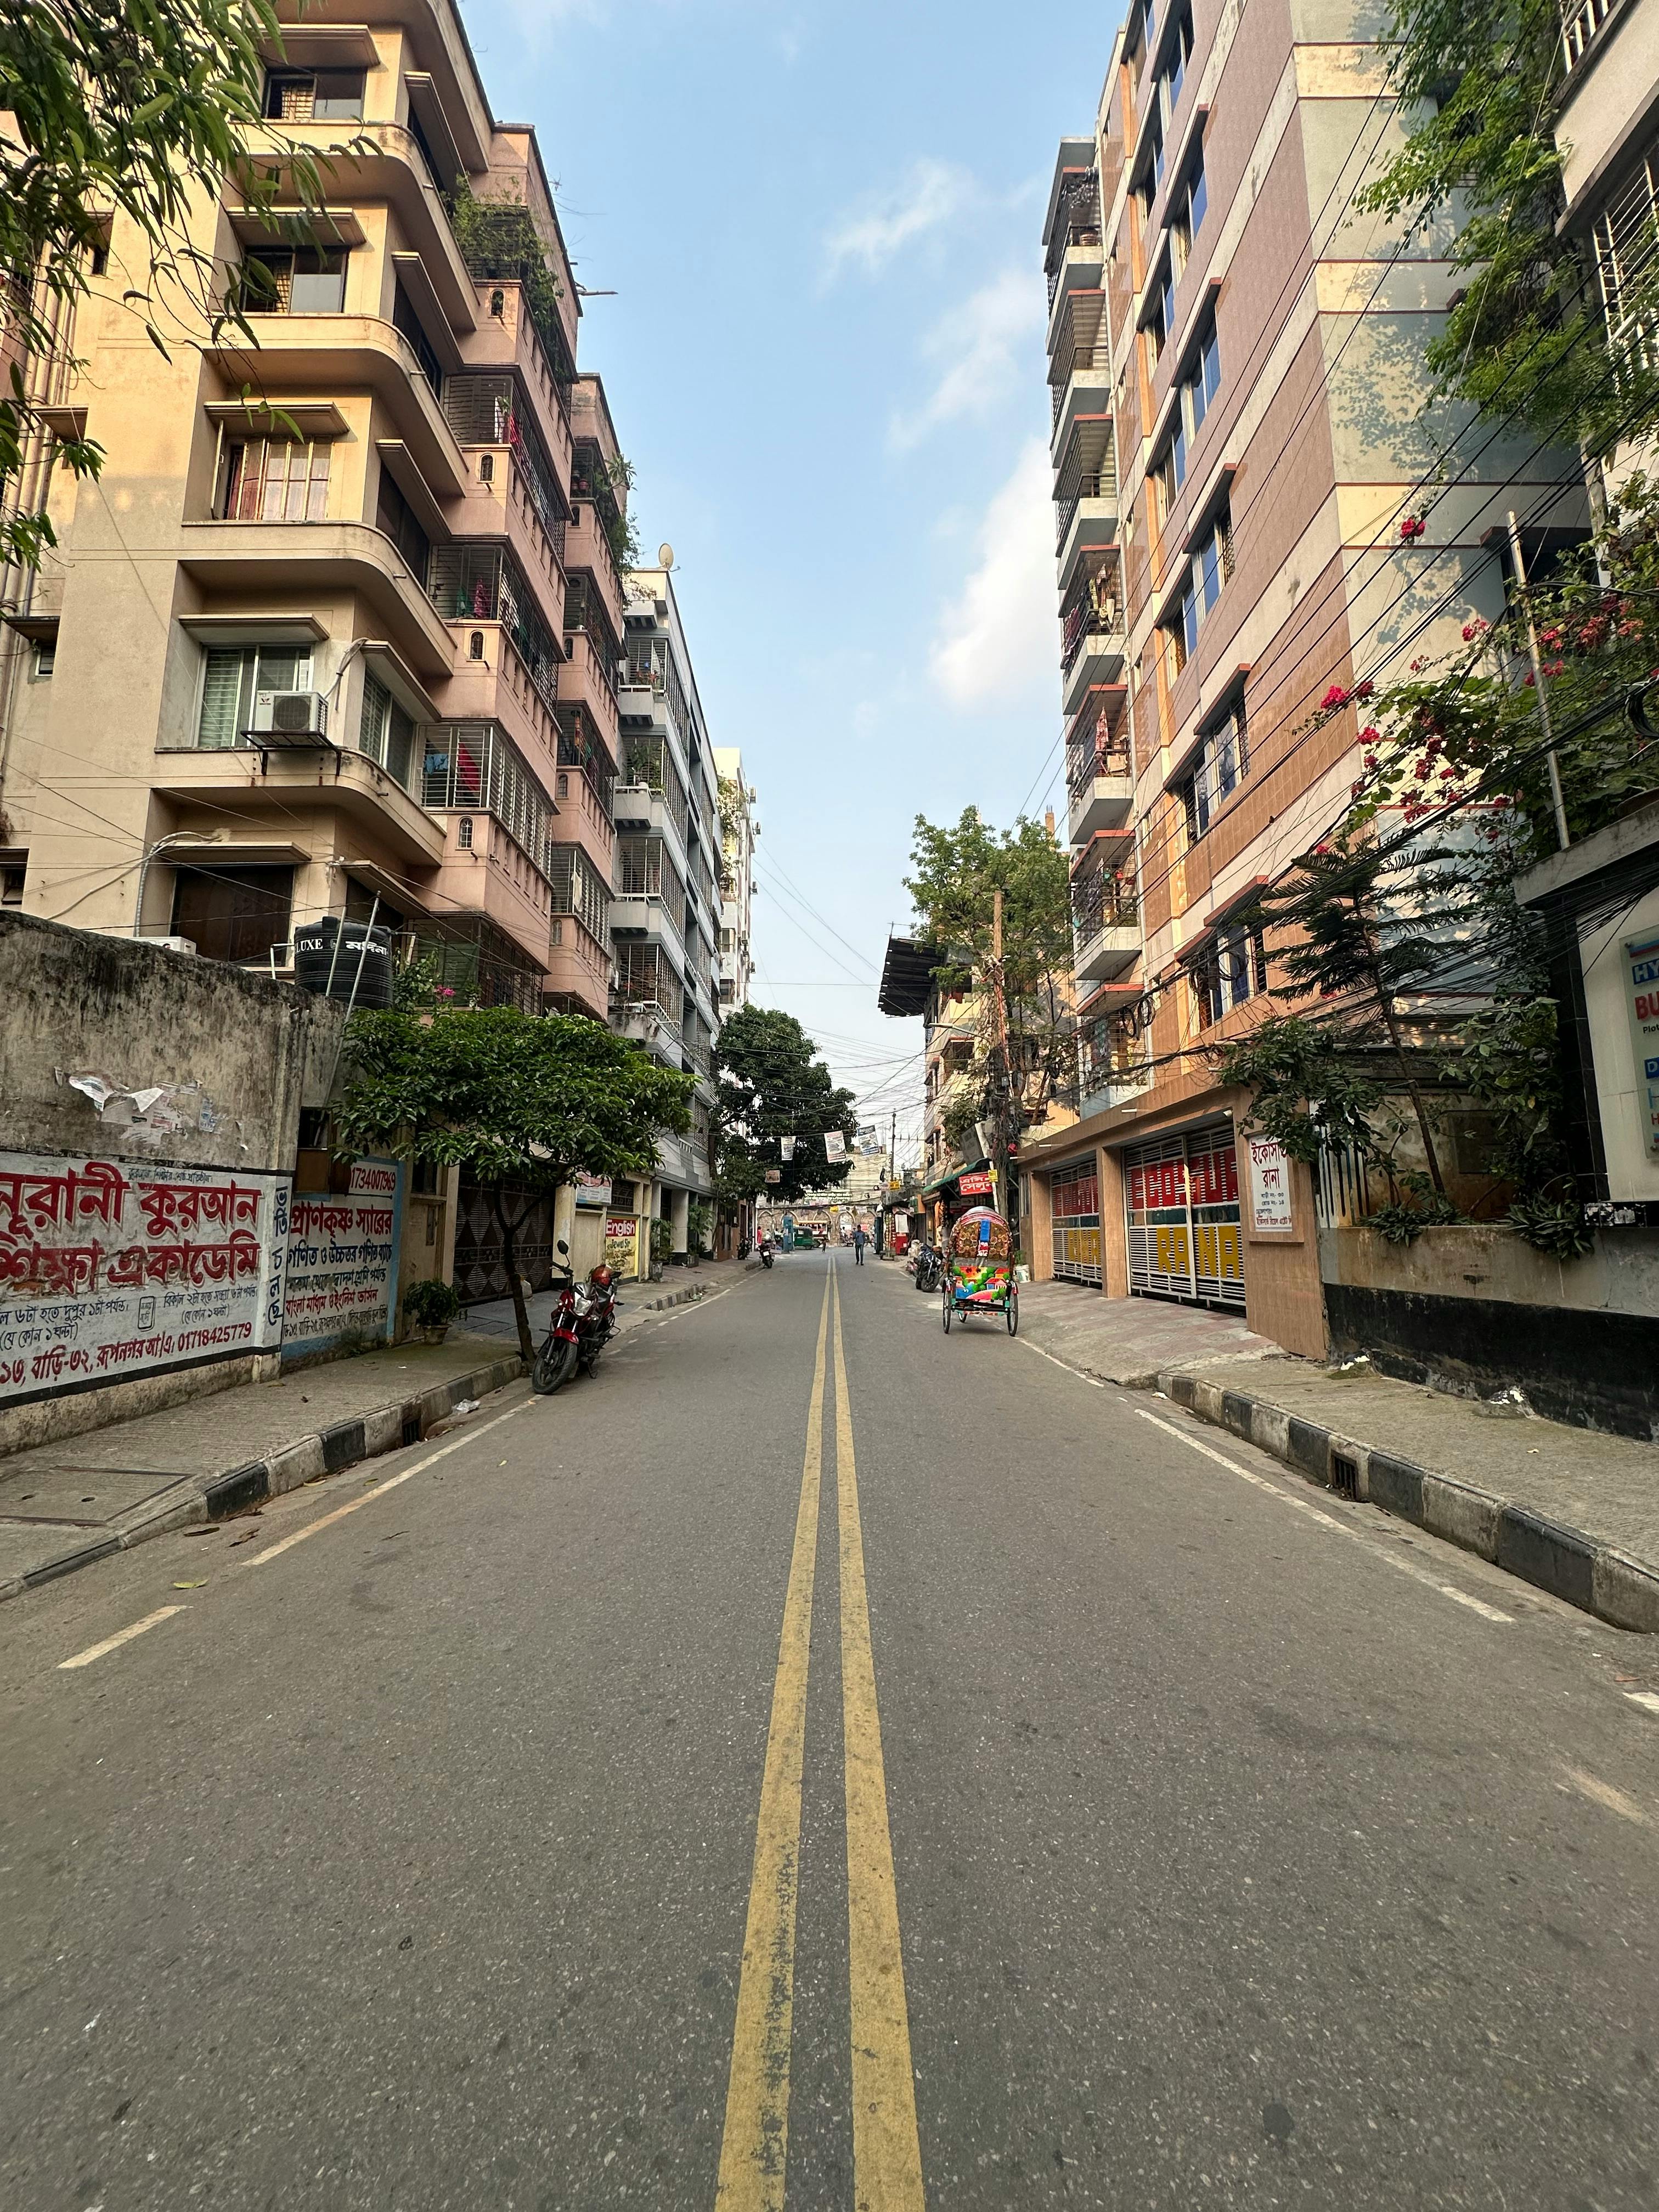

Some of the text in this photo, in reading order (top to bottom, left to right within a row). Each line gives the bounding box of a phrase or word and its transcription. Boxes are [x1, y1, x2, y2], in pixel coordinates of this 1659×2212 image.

[1261, 1165, 1280, 1189] রানা
[137, 1178, 263, 1235] কুরআন
[356, 1204, 394, 1236] স্যারের
[606, 1218, 635, 1237] English
[107, 1228, 262, 1286] একাডেমি
[287, 1239, 319, 1268] গণিত
[1156, 1224, 1240, 1279] RANA
[40, 1306, 63, 1323] হতে
[178, 1322, 252, 1352] 01718425779
